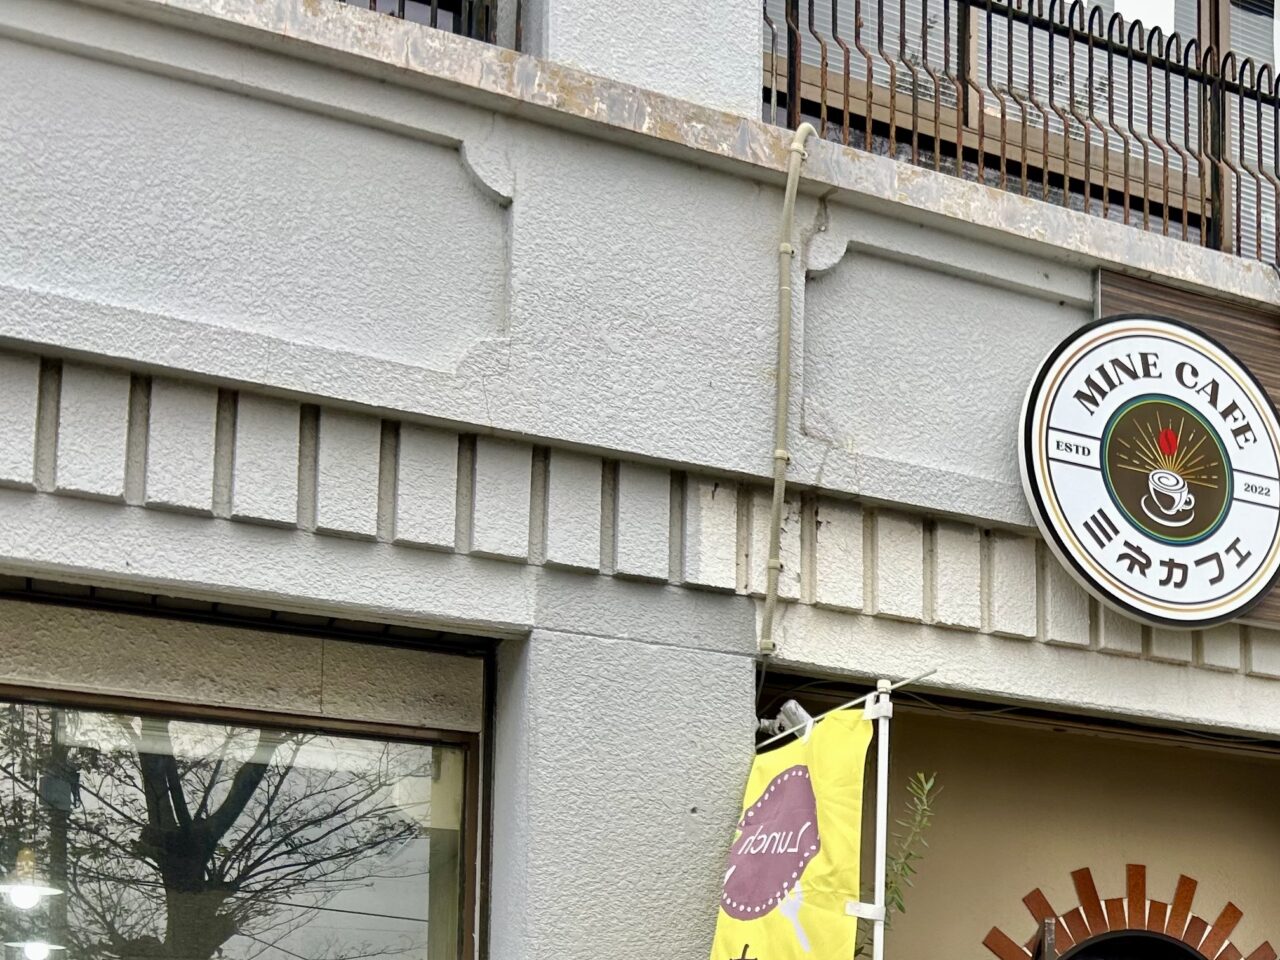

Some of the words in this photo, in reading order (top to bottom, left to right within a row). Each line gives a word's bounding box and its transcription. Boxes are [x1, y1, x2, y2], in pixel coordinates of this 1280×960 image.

[1073, 352, 1162, 416] MINE
[1175, 361, 1258, 450] CAFE
[1055, 440, 1091, 457] ESTD
[1243, 482, 1271, 497] 2022
[1082, 508, 1252, 589] ミネカフェ
